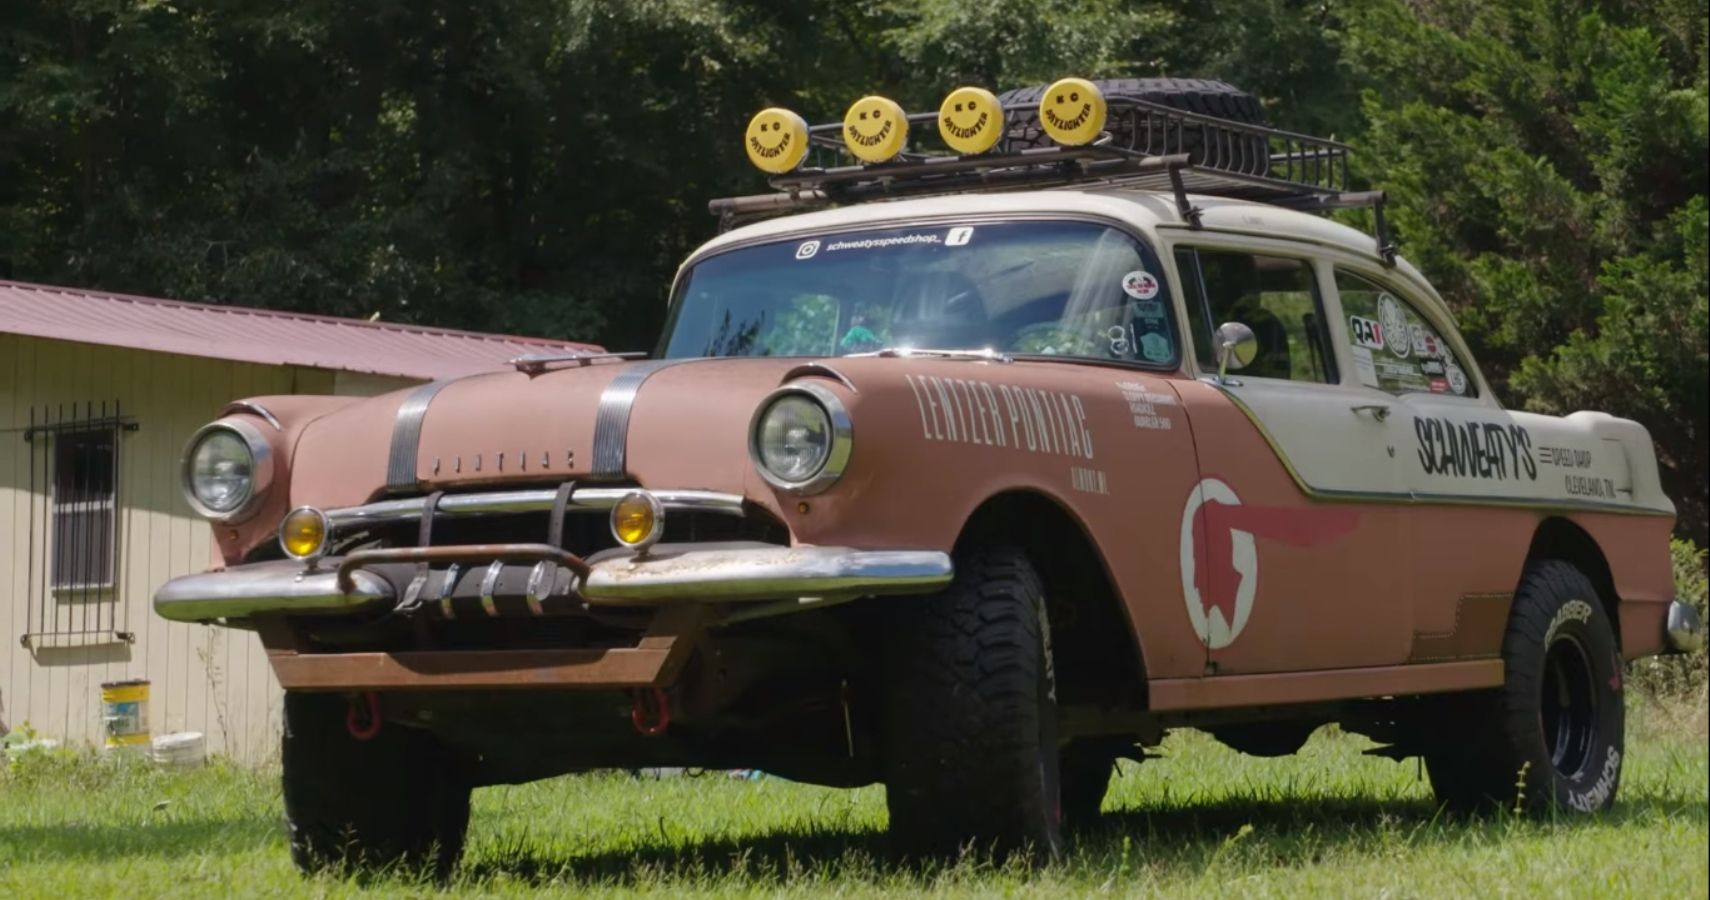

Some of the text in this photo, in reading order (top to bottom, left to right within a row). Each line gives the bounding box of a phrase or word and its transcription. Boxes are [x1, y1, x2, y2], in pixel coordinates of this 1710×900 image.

[944, 112, 988, 139] DAYLIGHTER
[1046, 103, 1091, 130] DAYLIGHTER
[750, 132, 791, 158] DAYLIGHTER
[849, 120, 892, 146] DAYLIGHTER
[905, 374, 1093, 459] LENTZER PONTIAC
[1413, 416, 1537, 481] SCHWEATY'S
